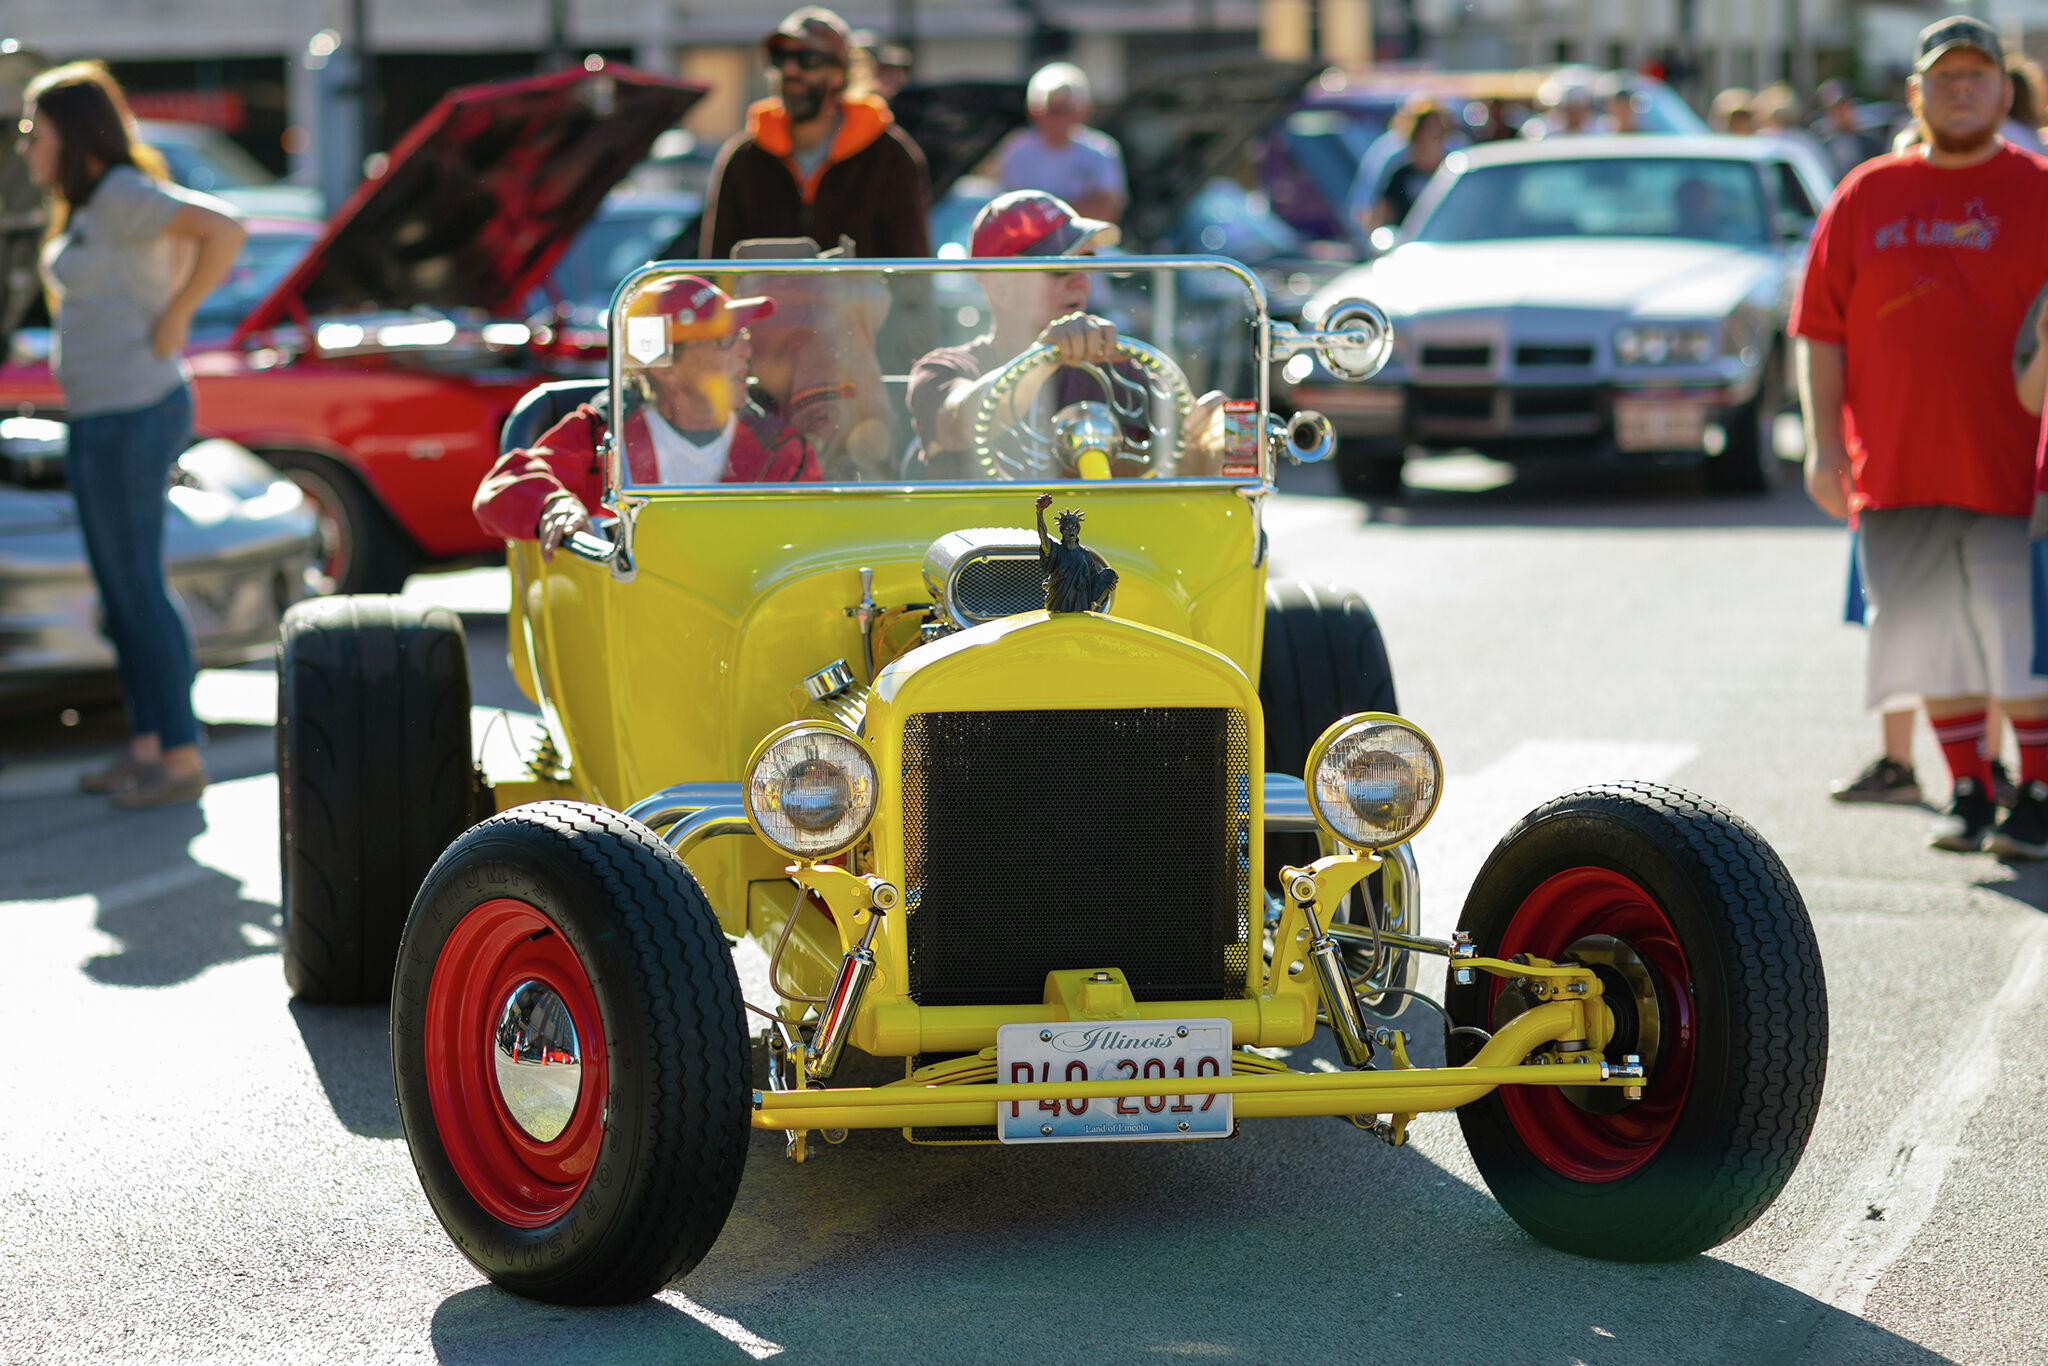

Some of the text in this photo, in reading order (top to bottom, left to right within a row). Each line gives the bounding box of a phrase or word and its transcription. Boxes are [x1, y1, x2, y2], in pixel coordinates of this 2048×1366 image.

[1051, 1026, 1176, 1053] Illinois
[1085, 1122, 1149, 1134] Land of Lincoln
[478, 1083, 626, 1268] SPORTSMAN
